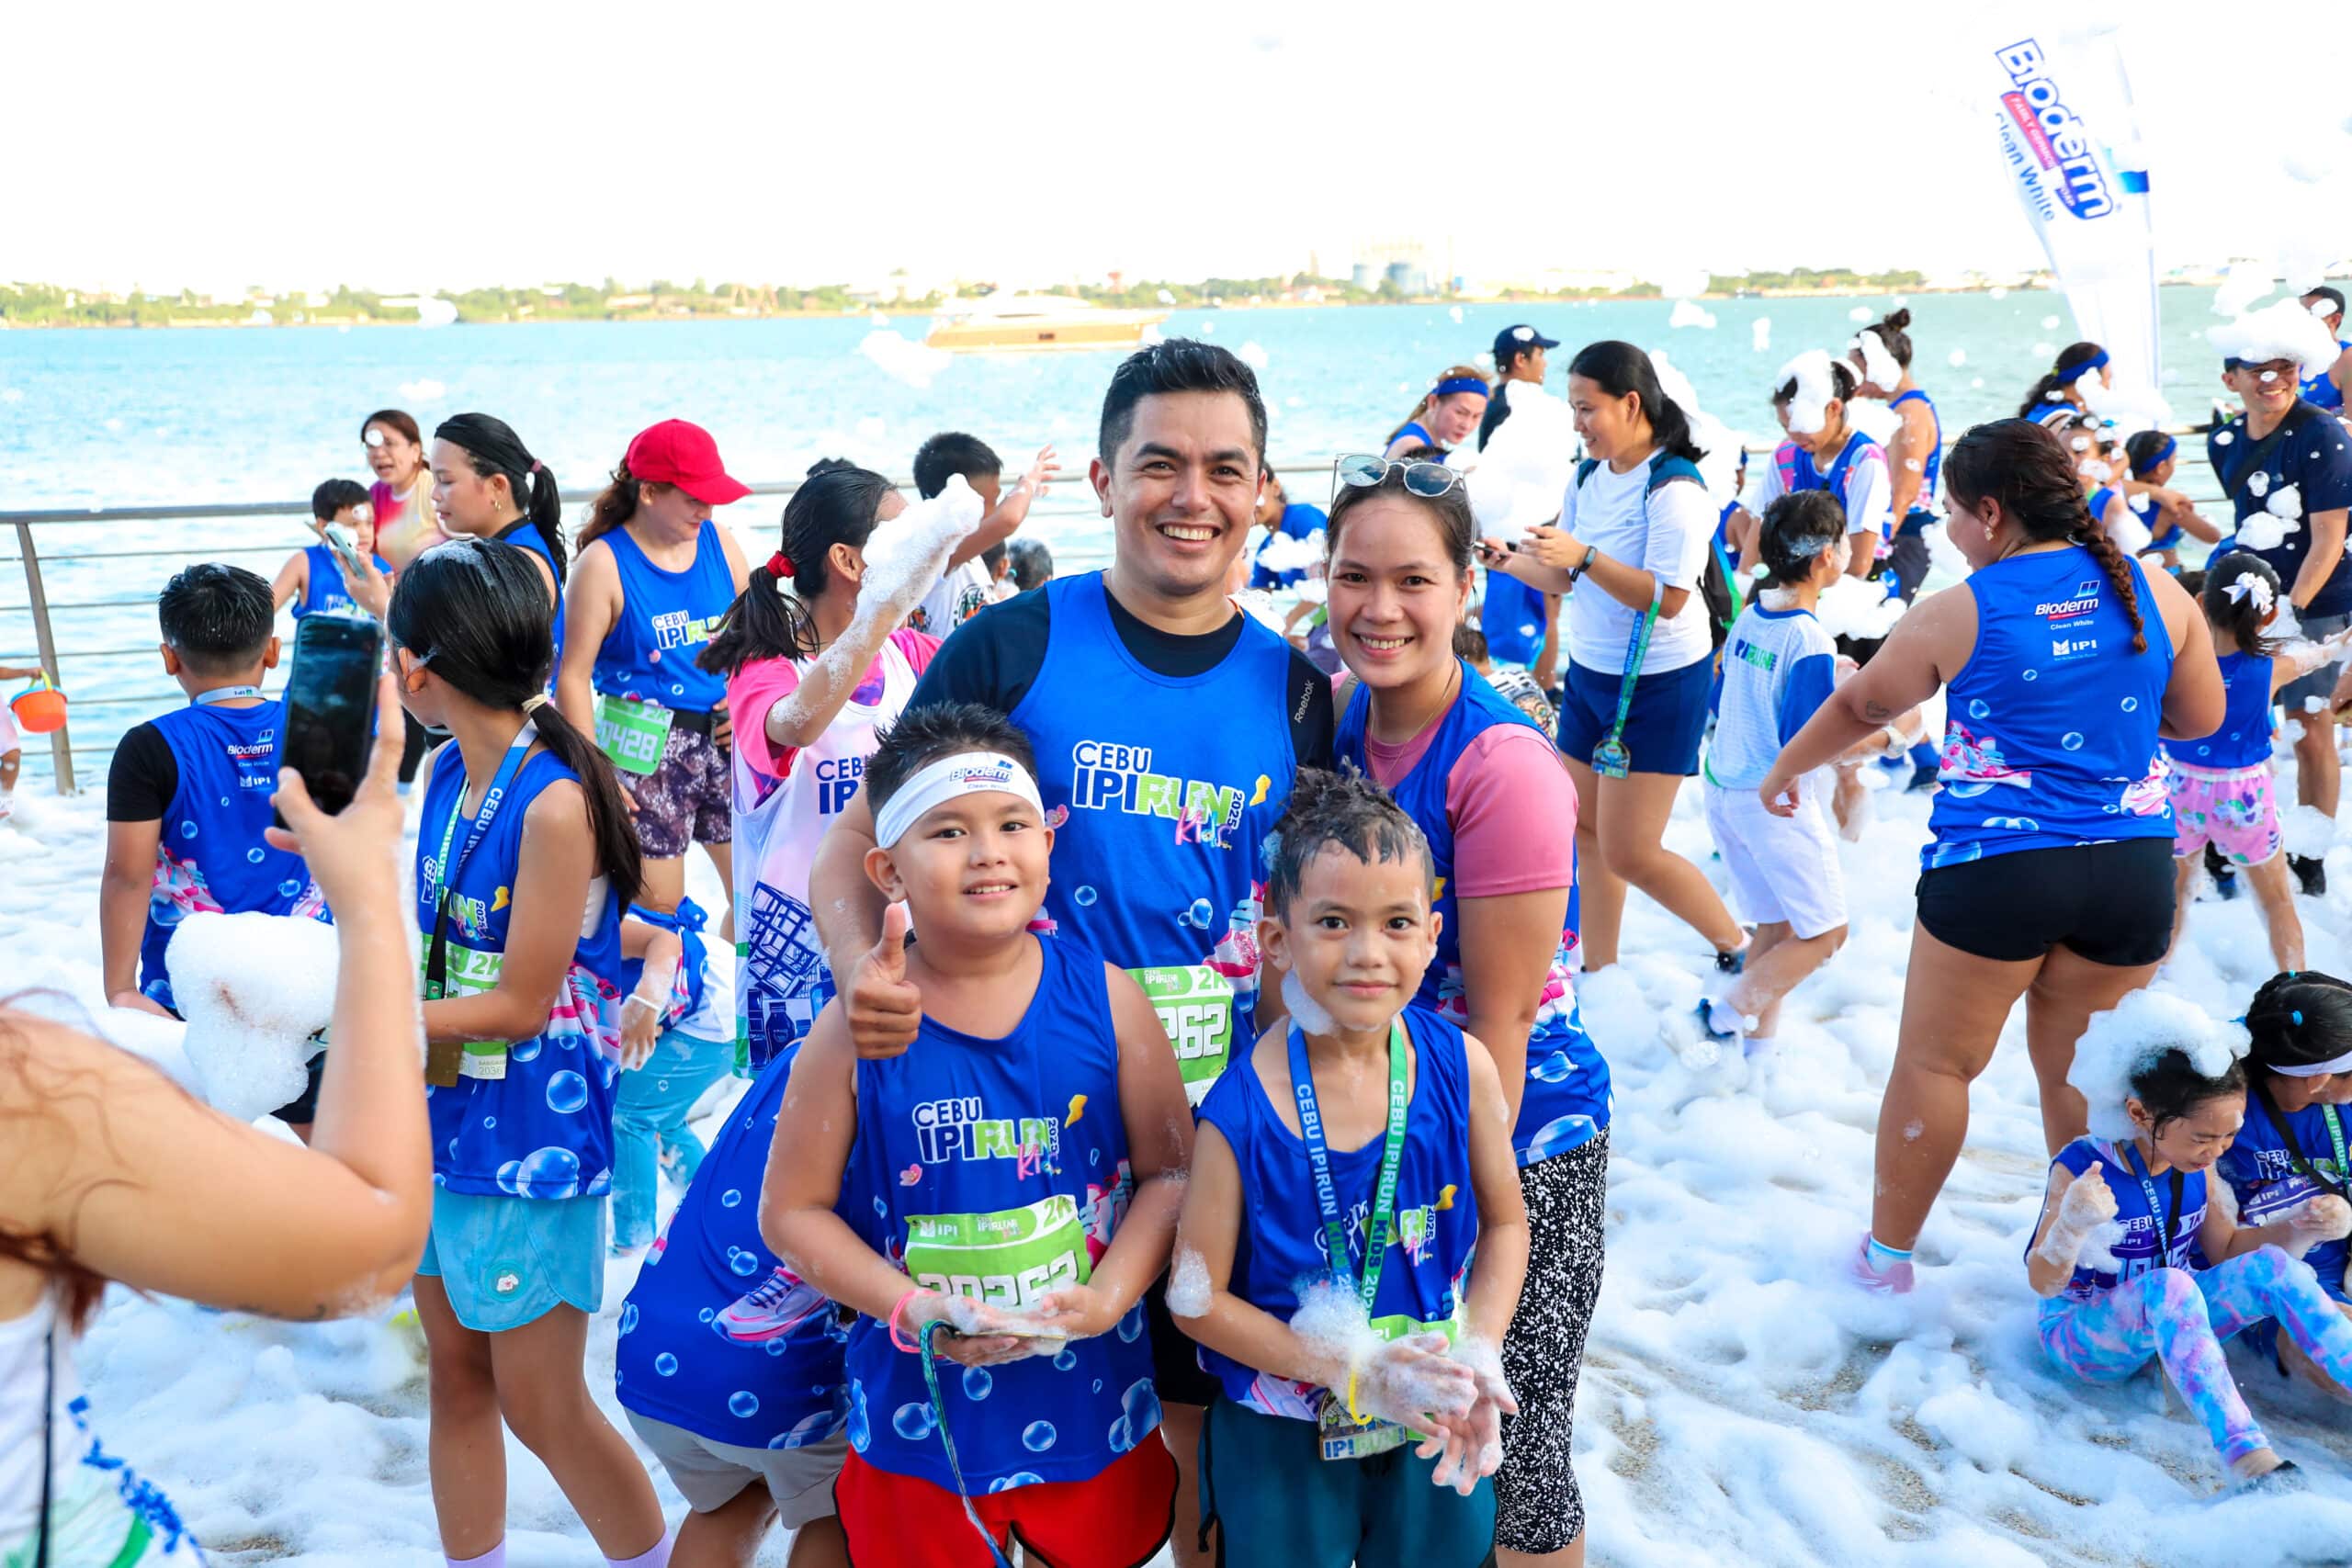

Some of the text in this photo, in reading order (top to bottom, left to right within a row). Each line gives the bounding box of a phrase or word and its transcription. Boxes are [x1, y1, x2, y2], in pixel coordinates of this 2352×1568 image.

[1995, 38, 2113, 220] Bioderm
[2019, 164, 2055, 221] White
[652, 611, 689, 629] CEBU
[2034, 598, 2099, 615] Bioderm
[2072, 639, 2098, 651] IPI
[1294, 680, 1315, 724] Reebok
[227, 742, 274, 755] Bioderm
[595, 719, 659, 764] 0428
[1073, 740, 1152, 774] CEBU
[253, 776, 271, 786] IPI
[816, 756, 864, 782] CEB
[949, 766, 1012, 782] Bioderm
[476, 787, 503, 831] CEBU
[1073, 766, 1244, 829] IPIRUN 2025
[1197, 967, 1229, 990] 2K
[1155, 1002, 1227, 1060] 262
[913, 1098, 982, 1128] CEBU
[919, 1118, 1051, 1163] IPIRUN
[1296, 1083, 1322, 1140] CEBU
[1310, 1146, 1339, 1216] IPIRUN
[1363, 1080, 1405, 1310] CEBU IPIRUN KIDS 202
[2142, 1179, 2162, 1213] CEBU
[938, 1224, 958, 1236] IPI
